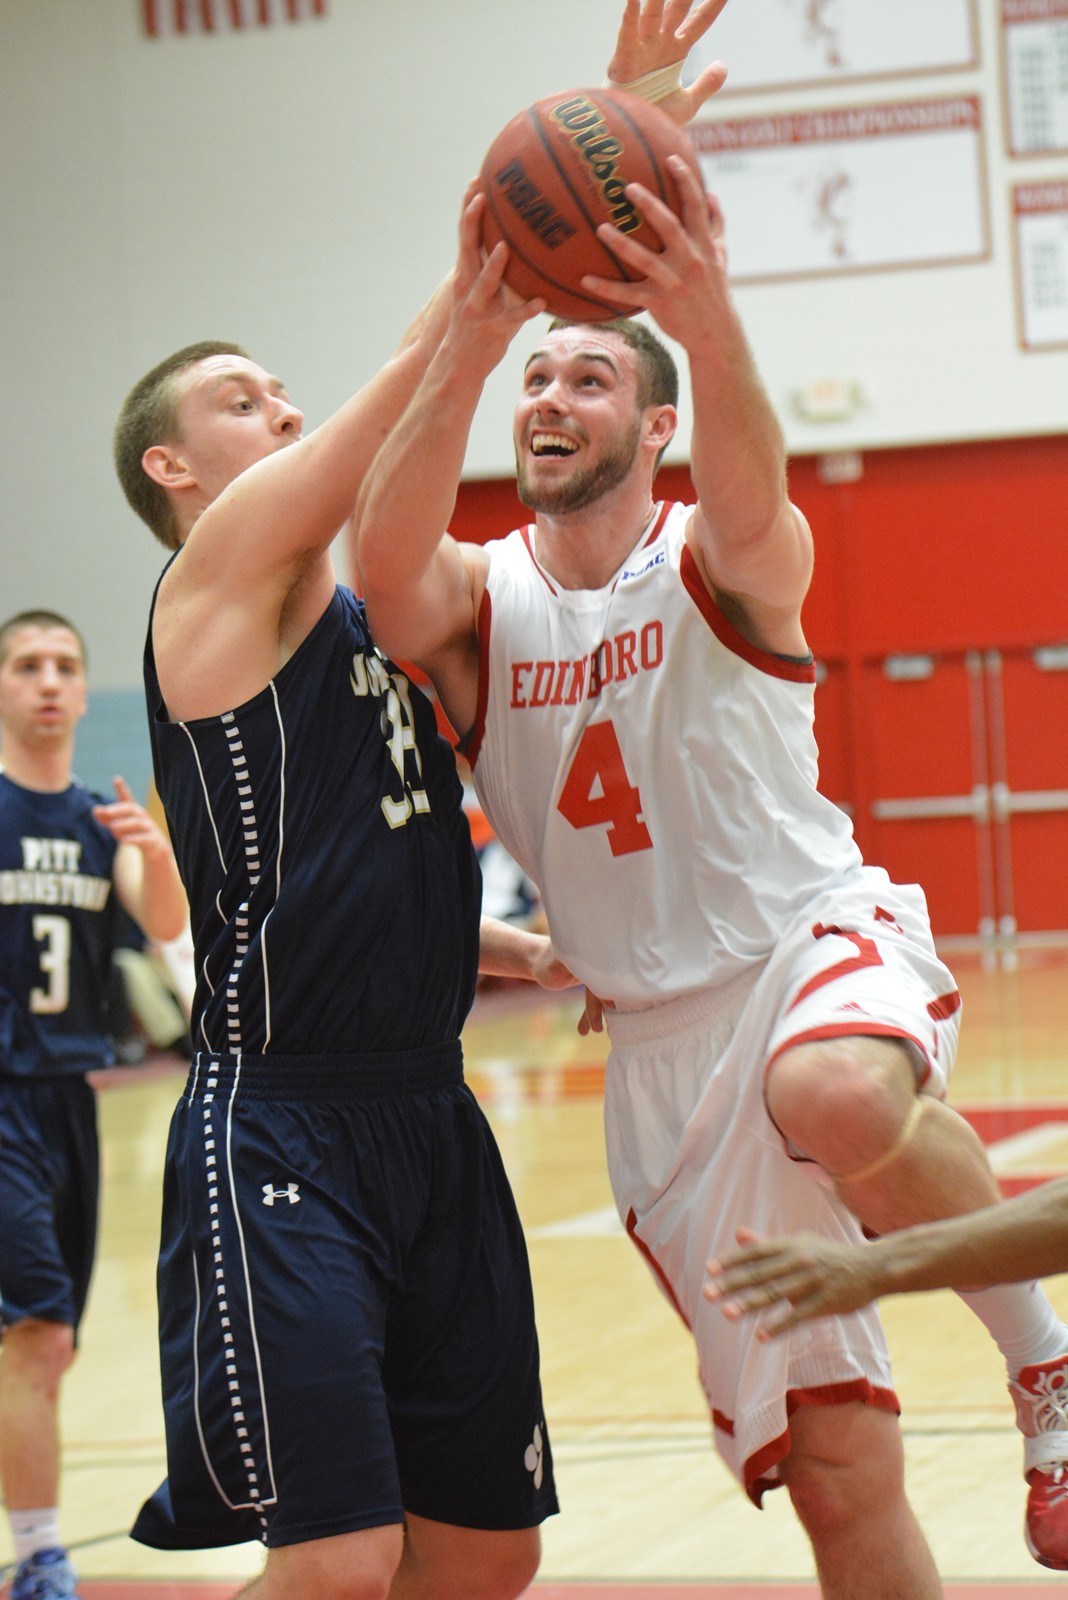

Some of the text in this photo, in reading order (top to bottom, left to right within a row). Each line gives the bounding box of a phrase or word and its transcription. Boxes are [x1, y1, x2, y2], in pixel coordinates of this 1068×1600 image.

[550, 95, 643, 235] Wilson
[510, 620, 663, 709] EDINBORO
[557, 719, 654, 857] 4
[29, 914, 71, 1014] 3
